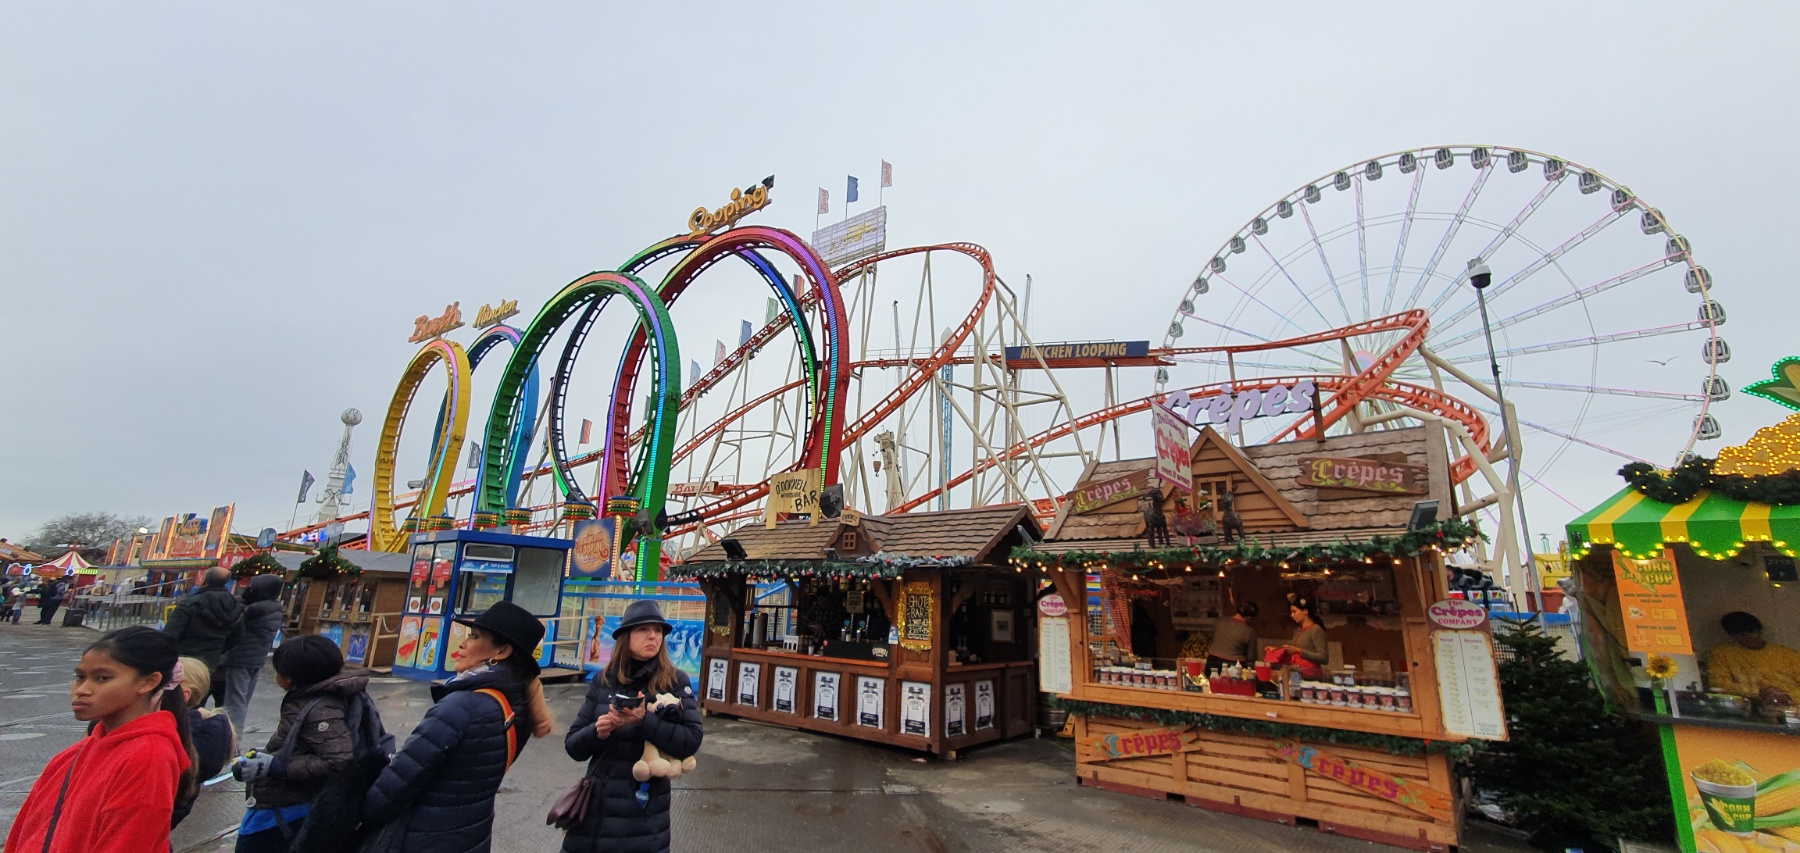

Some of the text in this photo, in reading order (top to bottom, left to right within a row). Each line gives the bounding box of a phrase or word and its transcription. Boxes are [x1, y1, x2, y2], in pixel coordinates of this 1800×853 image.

[688, 185, 768, 239] Looping
[408, 301, 461, 342] Barth
[1075, 343, 1126, 357] LOOPING
[671, 482, 710, 495] Barh
[795, 489, 818, 512] BAR
[1635, 562, 1671, 572] CORN
[1645, 574, 1673, 584] CUP
[909, 595, 928, 608] SHOT
[911, 608, 924, 619] BAR
